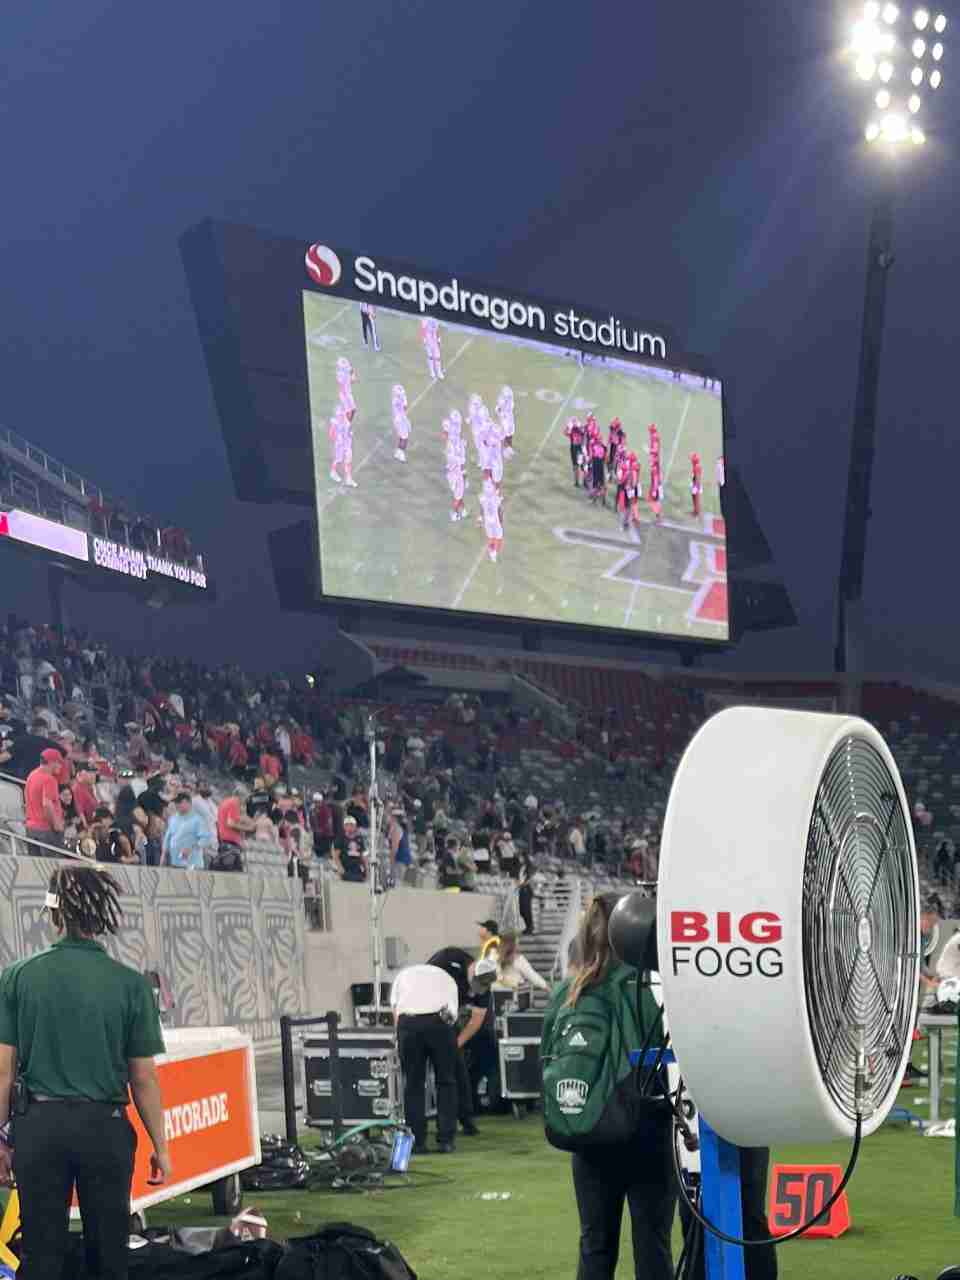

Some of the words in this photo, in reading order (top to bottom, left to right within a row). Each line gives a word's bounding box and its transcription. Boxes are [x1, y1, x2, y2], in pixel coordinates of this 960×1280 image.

[354, 256, 546, 330] Snapdragon
[553, 310, 667, 359] stadium
[130, 559, 147, 580] OUT
[147, 555, 174, 577] THANK
[174, 564, 190, 583] YOU
[190, 569, 207, 588] FOR
[670, 911, 783, 944] BIG
[672, 946, 784, 978] FOGG
[163, 1091, 229, 1141] ATORADE
[775, 1172, 834, 1227] 50
